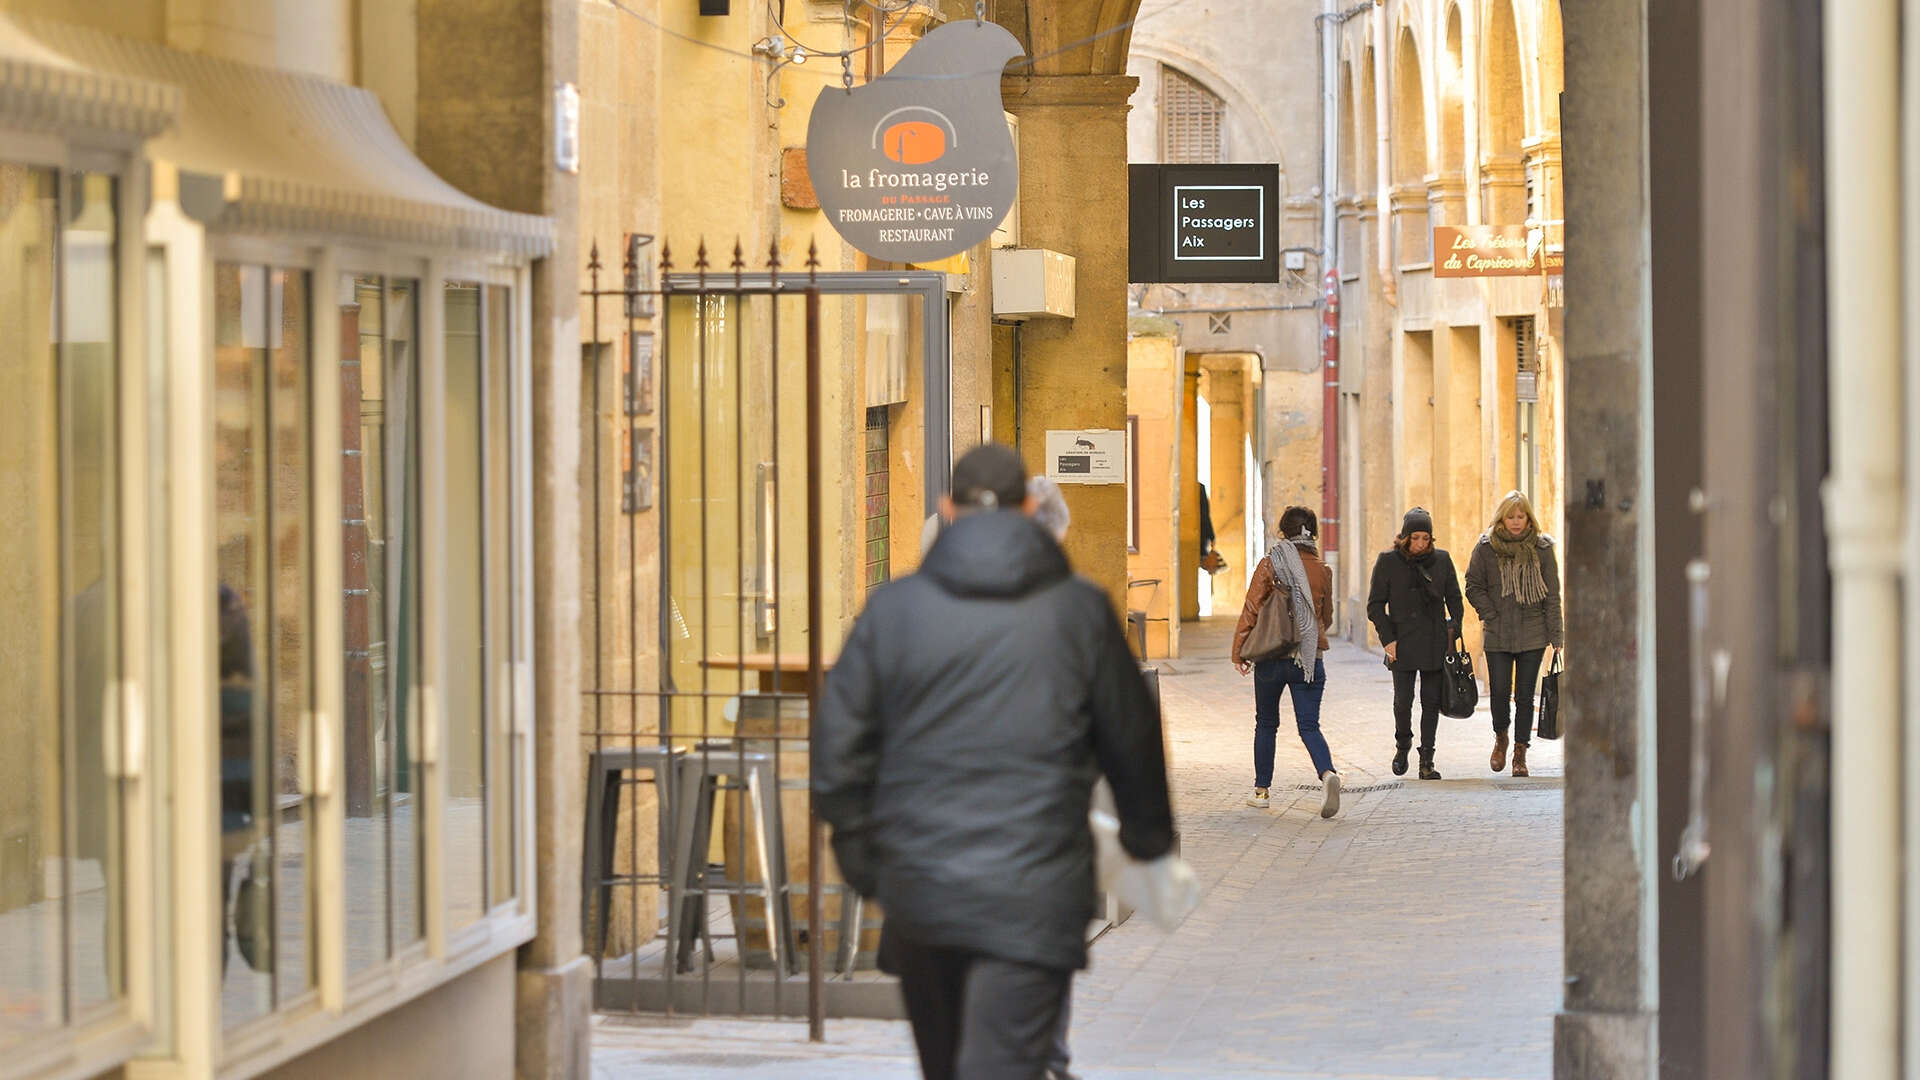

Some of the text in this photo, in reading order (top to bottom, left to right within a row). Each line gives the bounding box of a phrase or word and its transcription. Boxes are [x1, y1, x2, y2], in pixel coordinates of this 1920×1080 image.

[842, 168, 989, 191] la fromagerie
[1182, 197, 1205, 209] Les
[839, 203, 993, 222] FROMAGERIE CAVE À VINS
[1182, 216, 1255, 231] Passagers
[879, 228, 954, 242] RESTAURANT
[1182, 235, 1205, 247] Aix
[1452, 234, 1476, 250] Les
[1443, 253, 1463, 270] du
